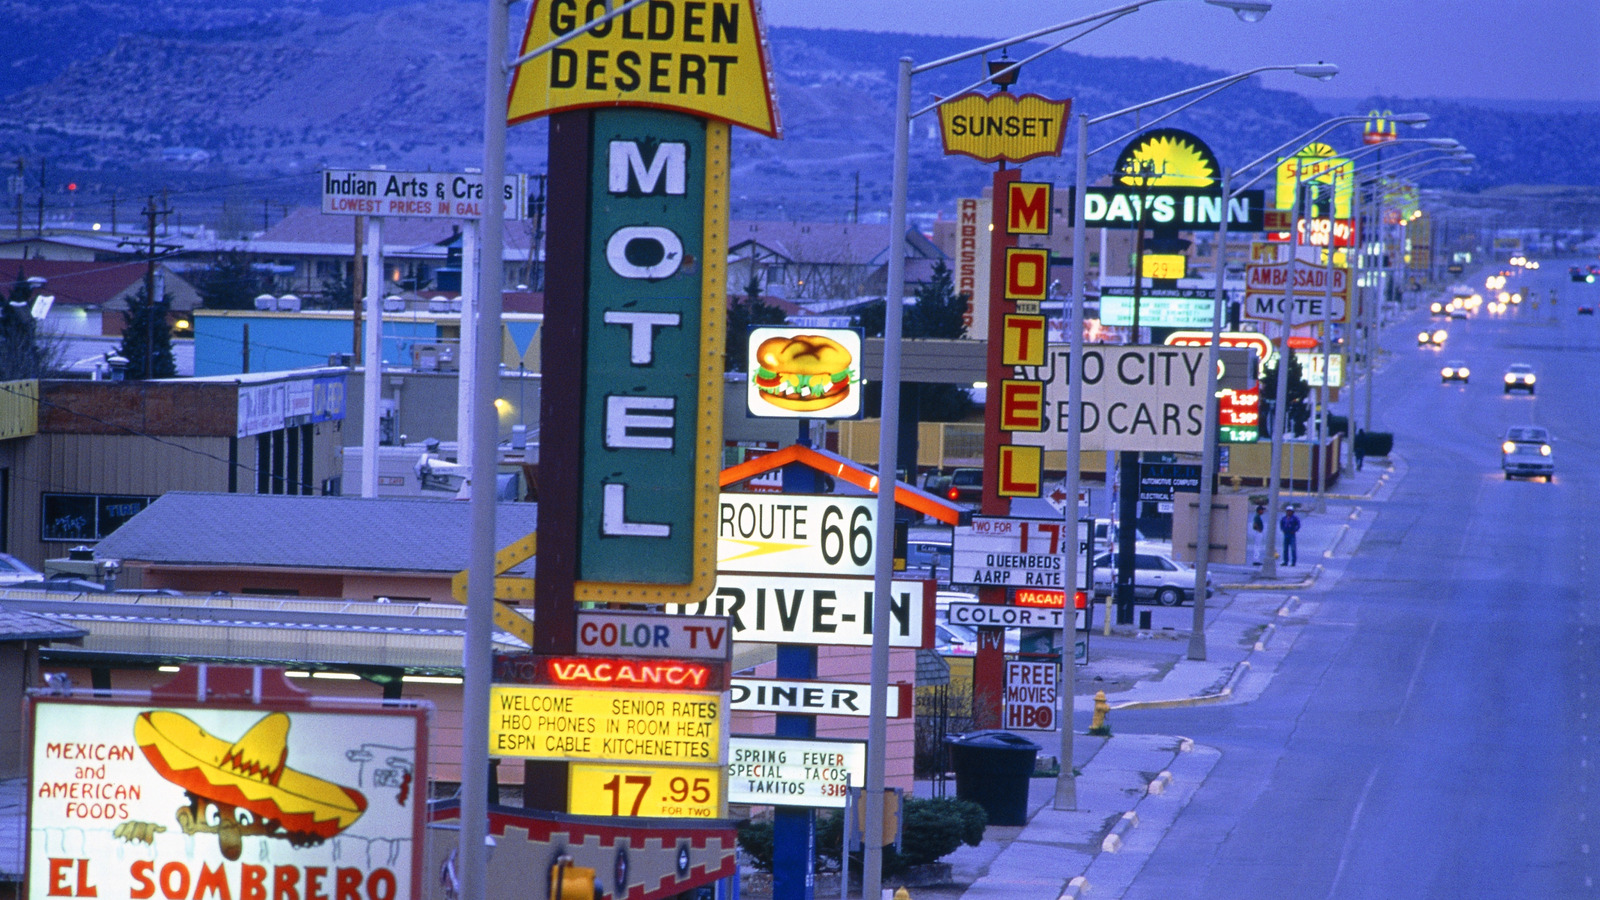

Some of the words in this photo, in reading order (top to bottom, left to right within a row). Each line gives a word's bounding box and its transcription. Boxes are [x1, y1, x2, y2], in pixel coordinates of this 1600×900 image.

[550, 0, 739, 44] GOLDEN
[550, 48, 739, 96] DESERT
[952, 115, 1053, 137] SUNSET
[325, 172, 377, 196] Indian
[384, 175, 428, 198] Arts
[436, 182, 445, 199] &
[452, 176, 513, 200] Cras
[331, 199, 382, 212] LOWEST
[389, 201, 431, 214] PRICES
[438, 203, 450, 214] IN
[1084, 194, 1175, 222] DAYS
[1183, 196, 1249, 223] INN
[1152, 262, 1168, 277] 29
[1251, 268, 1343, 288] AMBASADR
[1256, 297, 1338, 316] MOTE
[603, 140, 687, 537] MOTEL
[1001, 186, 1048, 493] MOTEL
[1117, 351, 1203, 387] CITY
[1107, 402, 1204, 436] CARS
[1140, 492, 1169, 501] ELECTRICAL
[720, 502, 807, 540] ROUTE
[821, 505, 873, 566] 66
[972, 521, 991, 532] TWO
[994, 522, 1012, 533] FOR
[1018, 522, 1060, 554] 17
[974, 570, 1011, 584] AARP
[1026, 572, 1061, 586] RATE
[1020, 593, 1080, 605] VACAN
[677, 587, 911, 637] RIVE-IN
[580, 622, 670, 647] COLOR
[683, 626, 726, 650] TV
[553, 662, 706, 685] VACANCY
[1009, 665, 1054, 685] FREE
[731, 684, 859, 711] DINER
[1008, 686, 1055, 703] MOVIES
[500, 695, 574, 713] WELCOME
[612, 699, 666, 716] SENIOR
[672, 701, 718, 719] RATES
[1008, 704, 1053, 728] HBO
[501, 714, 532, 731] HBO
[538, 716, 596, 733] PHONES
[606, 718, 621, 733] IN
[627, 719, 671, 736] ROOM
[677, 721, 713, 738] HEAT
[46, 742, 135, 761] MEXICAN
[498, 734, 536, 751] ESPN
[545, 736, 592, 753] CABLE
[602, 738, 711, 758] KITCHENETTES
[735, 749, 787, 764] SPRING
[803, 752, 845, 767] FEVER
[75, 764, 106, 780] and
[728, 763, 783, 779] SPECIAL
[804, 767, 848, 782] TACOS
[38, 781, 141, 801] AMERICAN
[603, 775, 652, 817] 17
[661, 777, 711, 804] .95
[748, 780, 806, 795] TAKITOS
[66, 802, 129, 820] FOODS
[661, 807, 683, 816] FOR
[687, 808, 711, 817] TWO
[48, 858, 98, 897] EL
[130, 860, 397, 900] SOMBRERO
